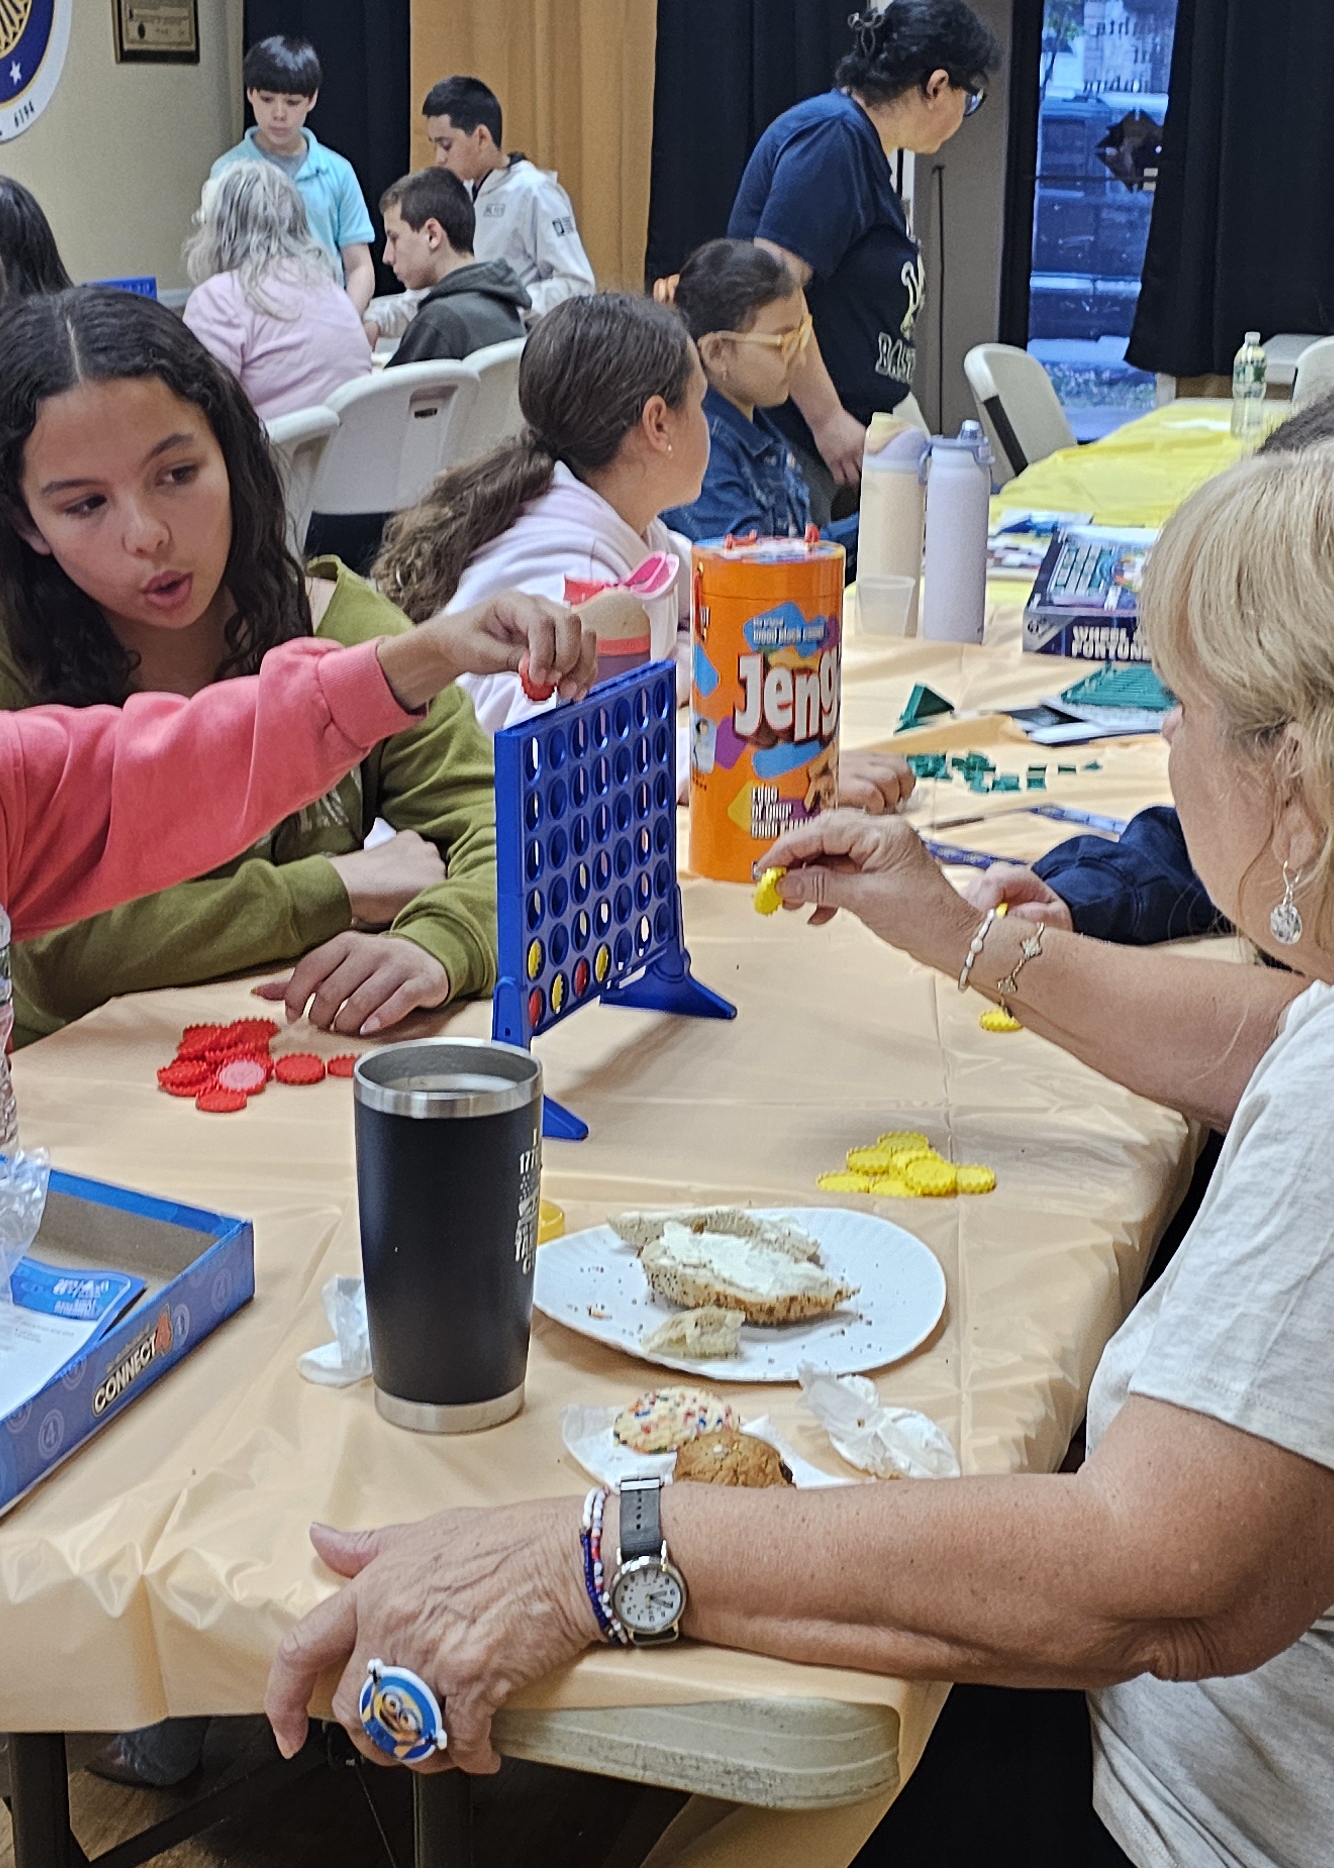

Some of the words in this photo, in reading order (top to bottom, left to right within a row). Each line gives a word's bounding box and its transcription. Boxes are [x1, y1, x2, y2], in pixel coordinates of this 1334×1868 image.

[13, 100, 36, 128] 6194
[1072, 625, 1129, 642] WHEEL
[734, 649, 841, 742] Jeng
[94, 1333, 157, 1415] CONNECT
